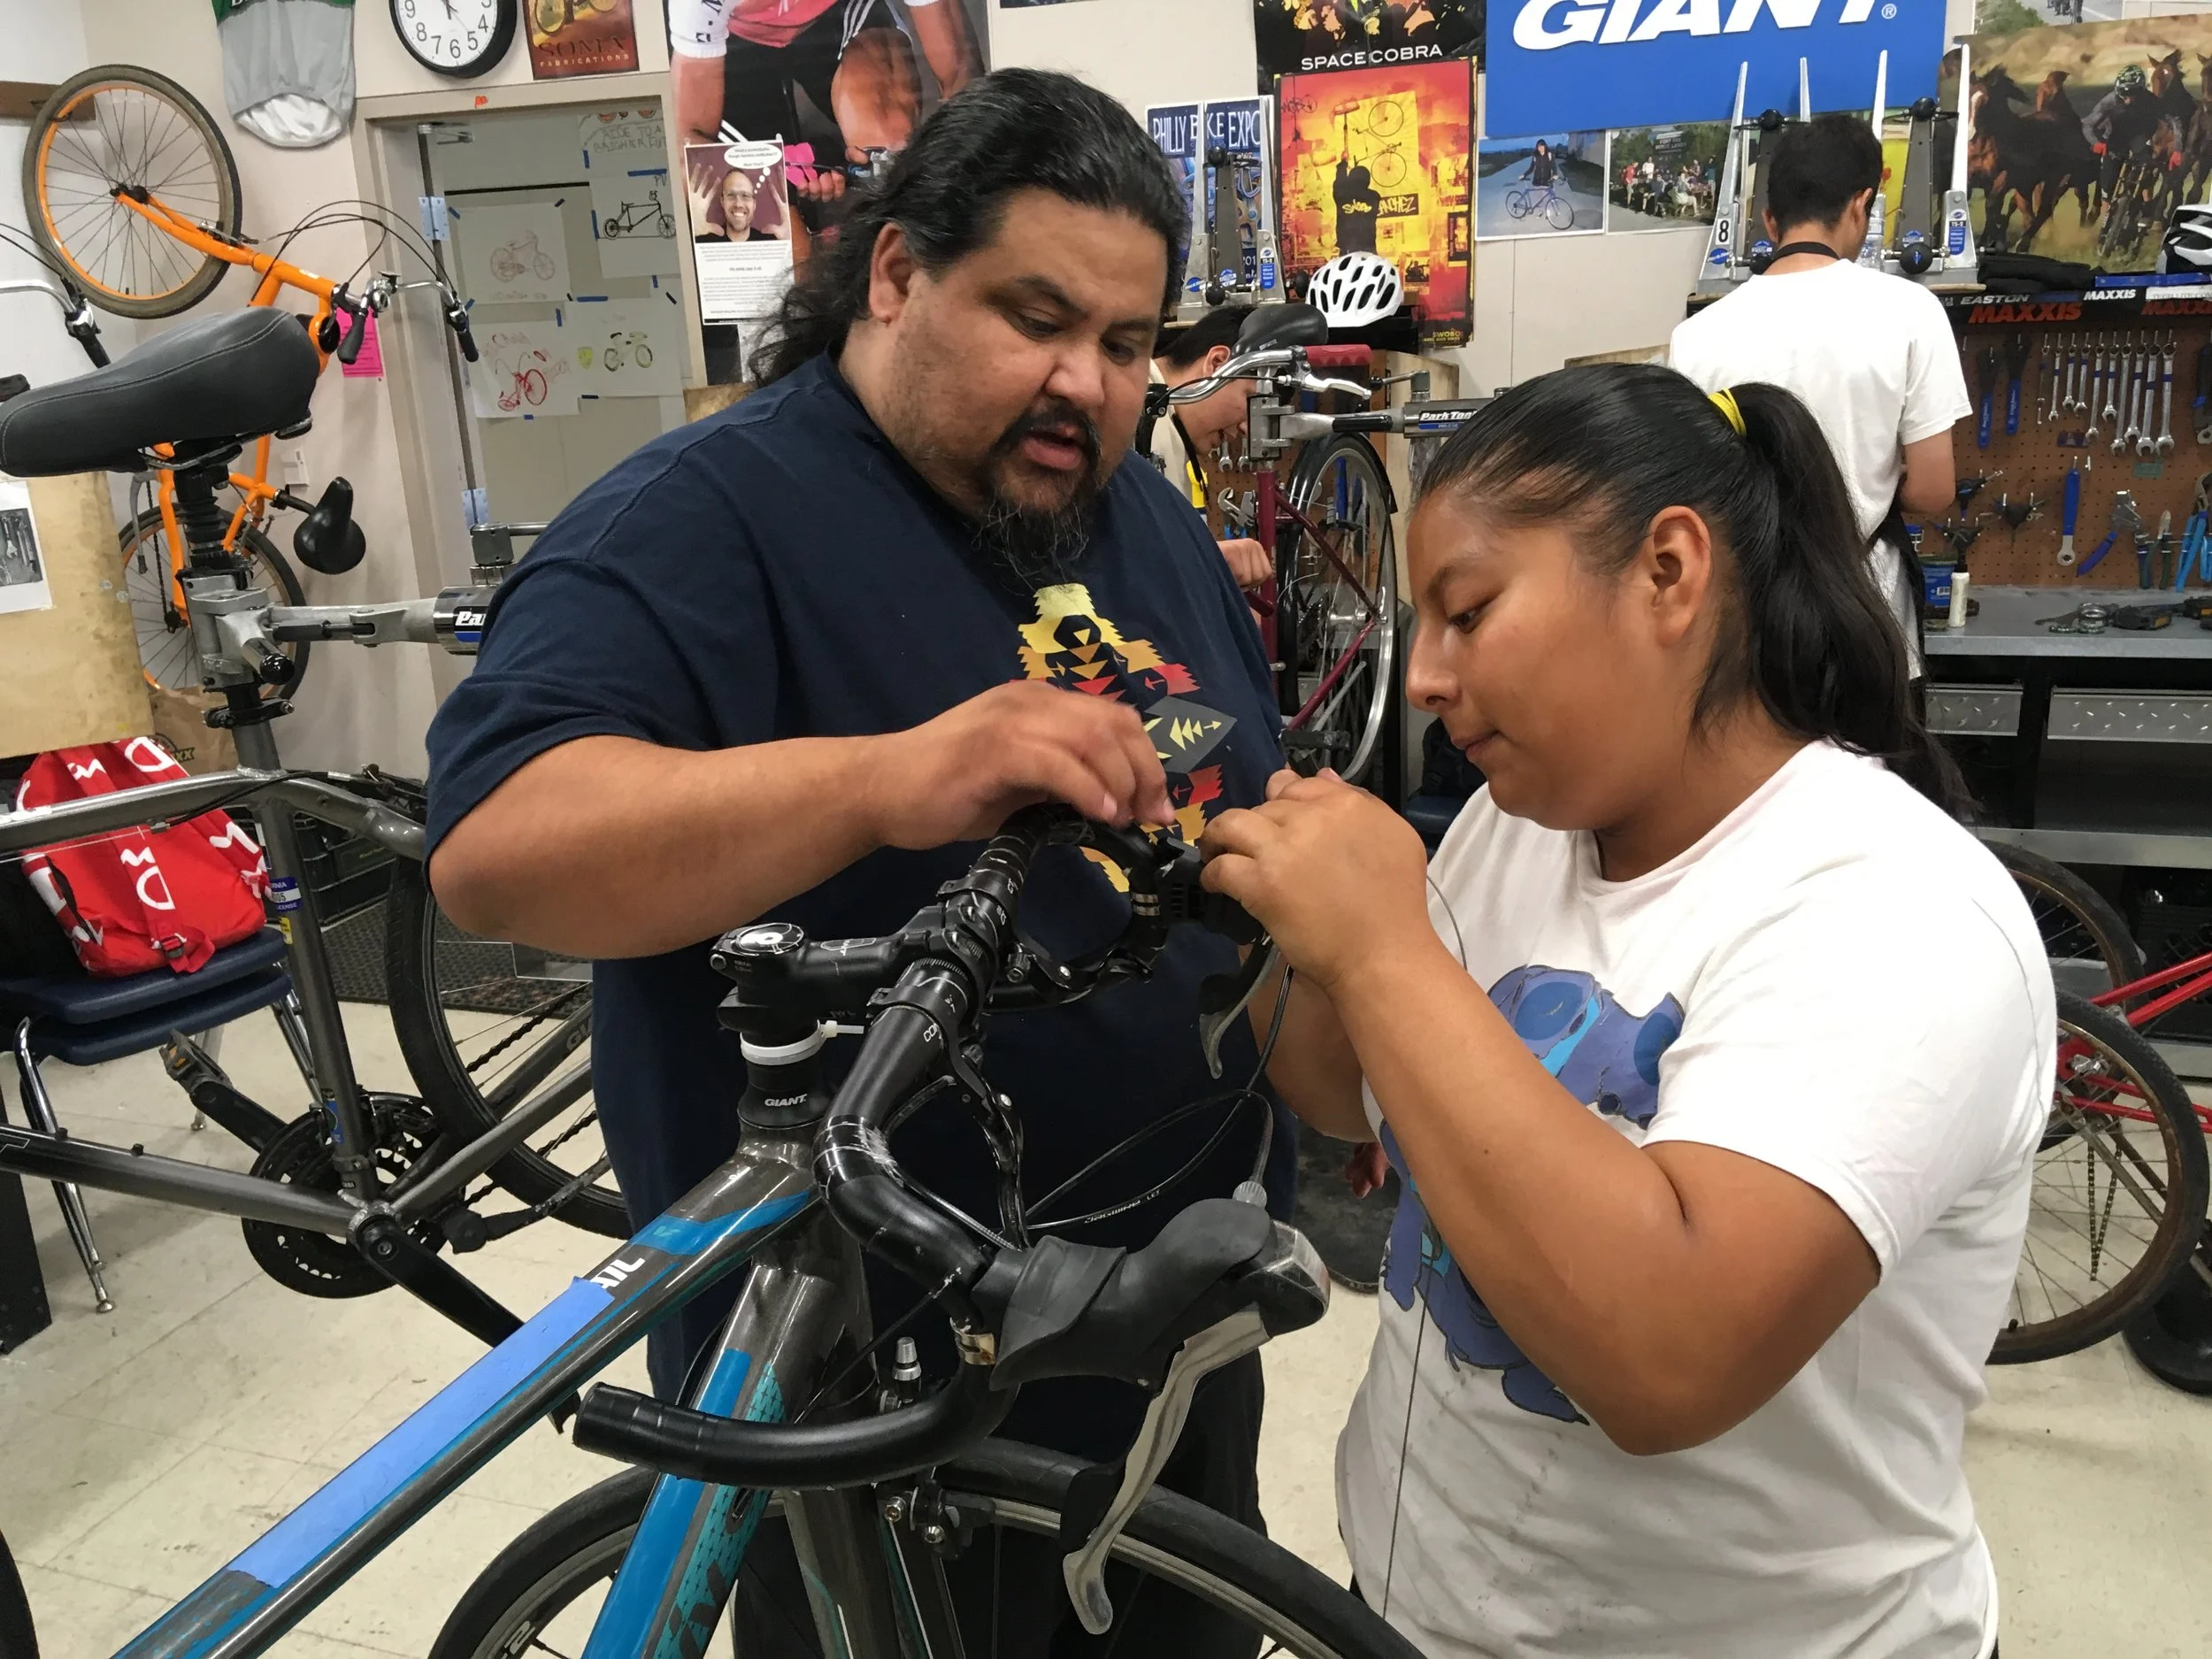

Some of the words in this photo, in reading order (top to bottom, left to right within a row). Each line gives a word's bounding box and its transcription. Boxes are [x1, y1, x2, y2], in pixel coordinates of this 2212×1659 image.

[416, 22, 427, 42] 8
[478, 14, 488, 33] 4
[431, 35, 442, 55] 7
[449, 39, 461, 58] 6
[467, 31, 479, 50] 5
[540, 53, 630, 68] FABRICATIONS
[1301, 51, 1367, 71] SPACE
[1370, 44, 1443, 63] COBRA
[1153, 115, 1187, 153] PHILLY
[1190, 111, 1225, 140] BKE
[1718, 219, 1730, 243] 8
[1960, 294, 2031, 305] EASTON
[2084, 288, 2137, 301] MAXXIS
[1968, 303, 2082, 324] MAXXIS
[1449, 411, 1478, 420] Too
[764, 1093, 808, 1107] GIANT
